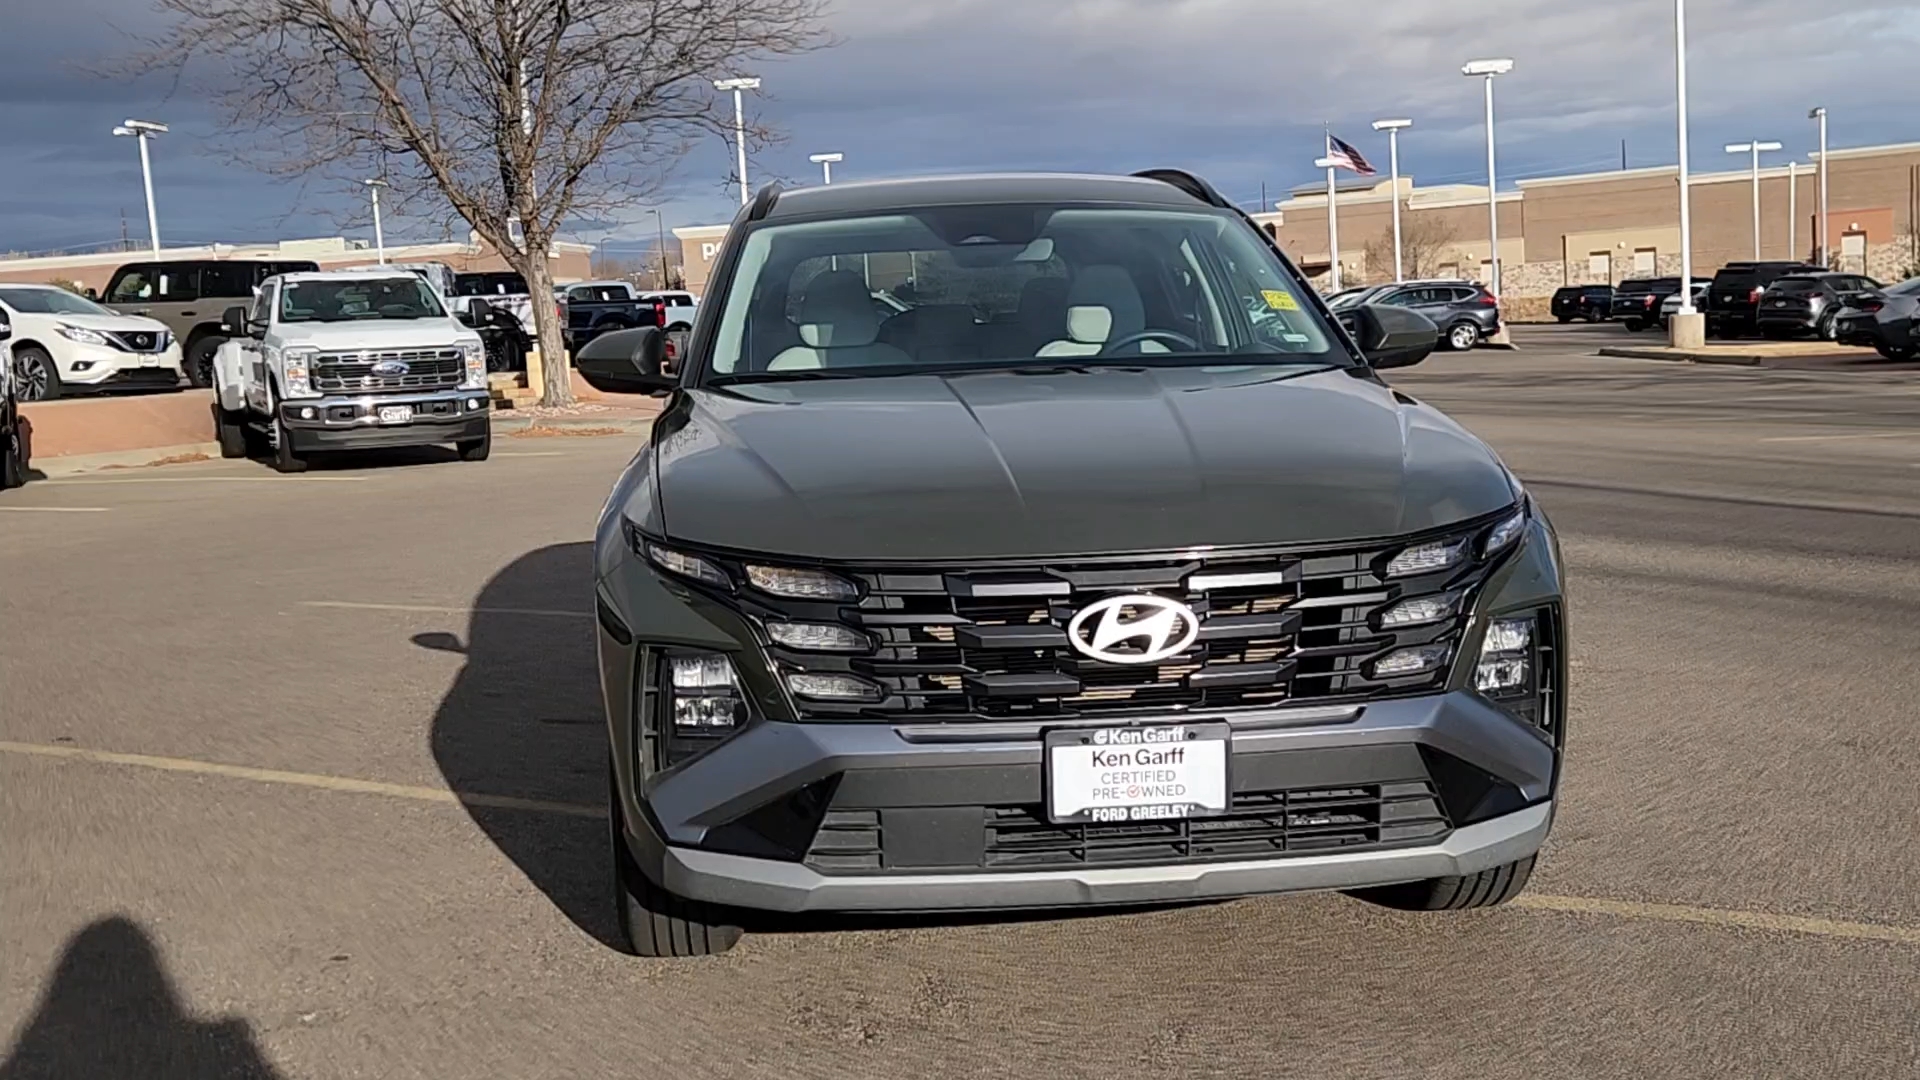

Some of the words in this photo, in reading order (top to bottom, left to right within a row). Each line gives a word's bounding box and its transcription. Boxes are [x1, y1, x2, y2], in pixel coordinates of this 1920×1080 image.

[1109, 728, 1142, 744] Ken
[1142, 726, 1185, 743] Garff
[1092, 750, 1131, 768] Ken
[1135, 747, 1185, 766] Garff
[1101, 770, 1176, 785] CERTIFIED
[1092, 807, 1128, 822] FORD
[1130, 803, 1189, 820] GREELEY
